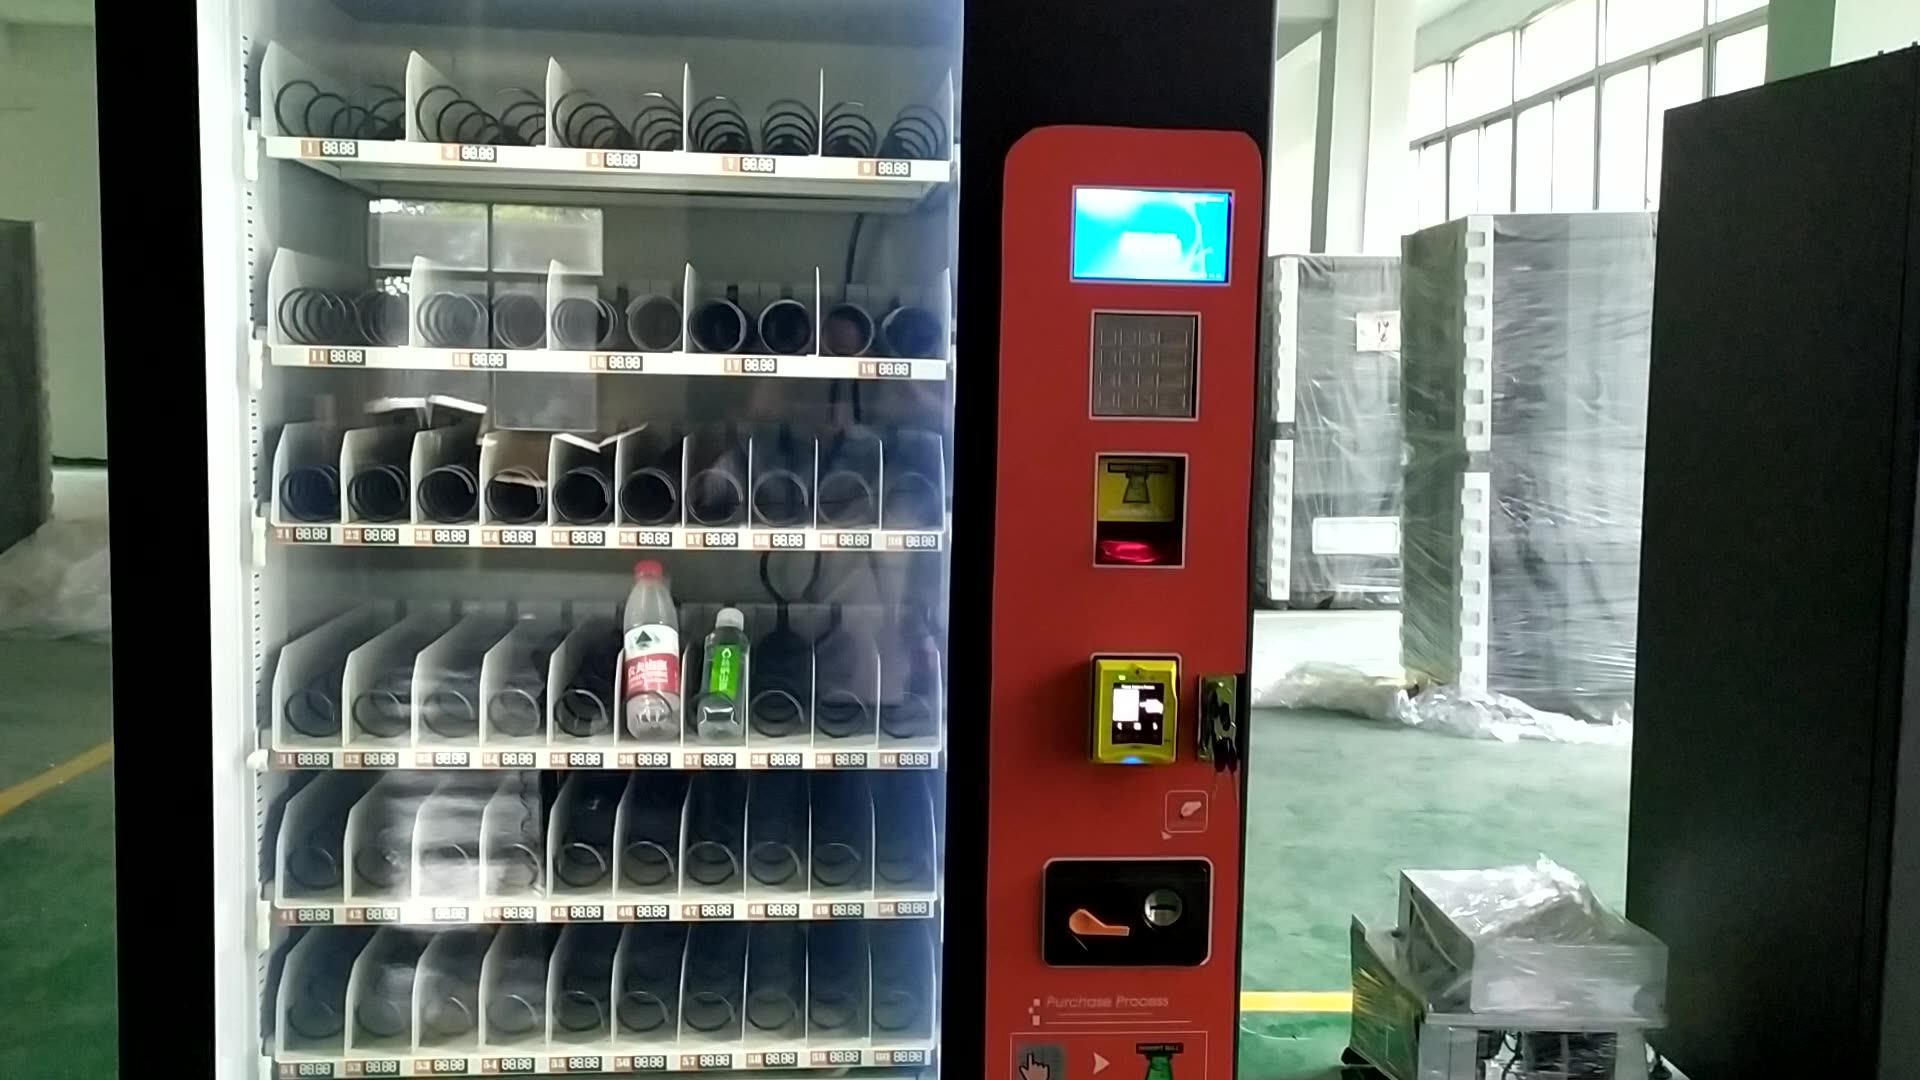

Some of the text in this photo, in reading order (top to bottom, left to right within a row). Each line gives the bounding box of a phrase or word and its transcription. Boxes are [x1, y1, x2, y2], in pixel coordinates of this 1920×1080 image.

[313, 350, 326, 363] 11
[685, 754, 699, 765] 37
[280, 909, 294, 920] 41
[683, 905, 697, 916] 47
[1047, 995, 1169, 1009] Purchase Process
[483, 1058, 497, 1069] 54
[682, 1055, 696, 1065] 57
